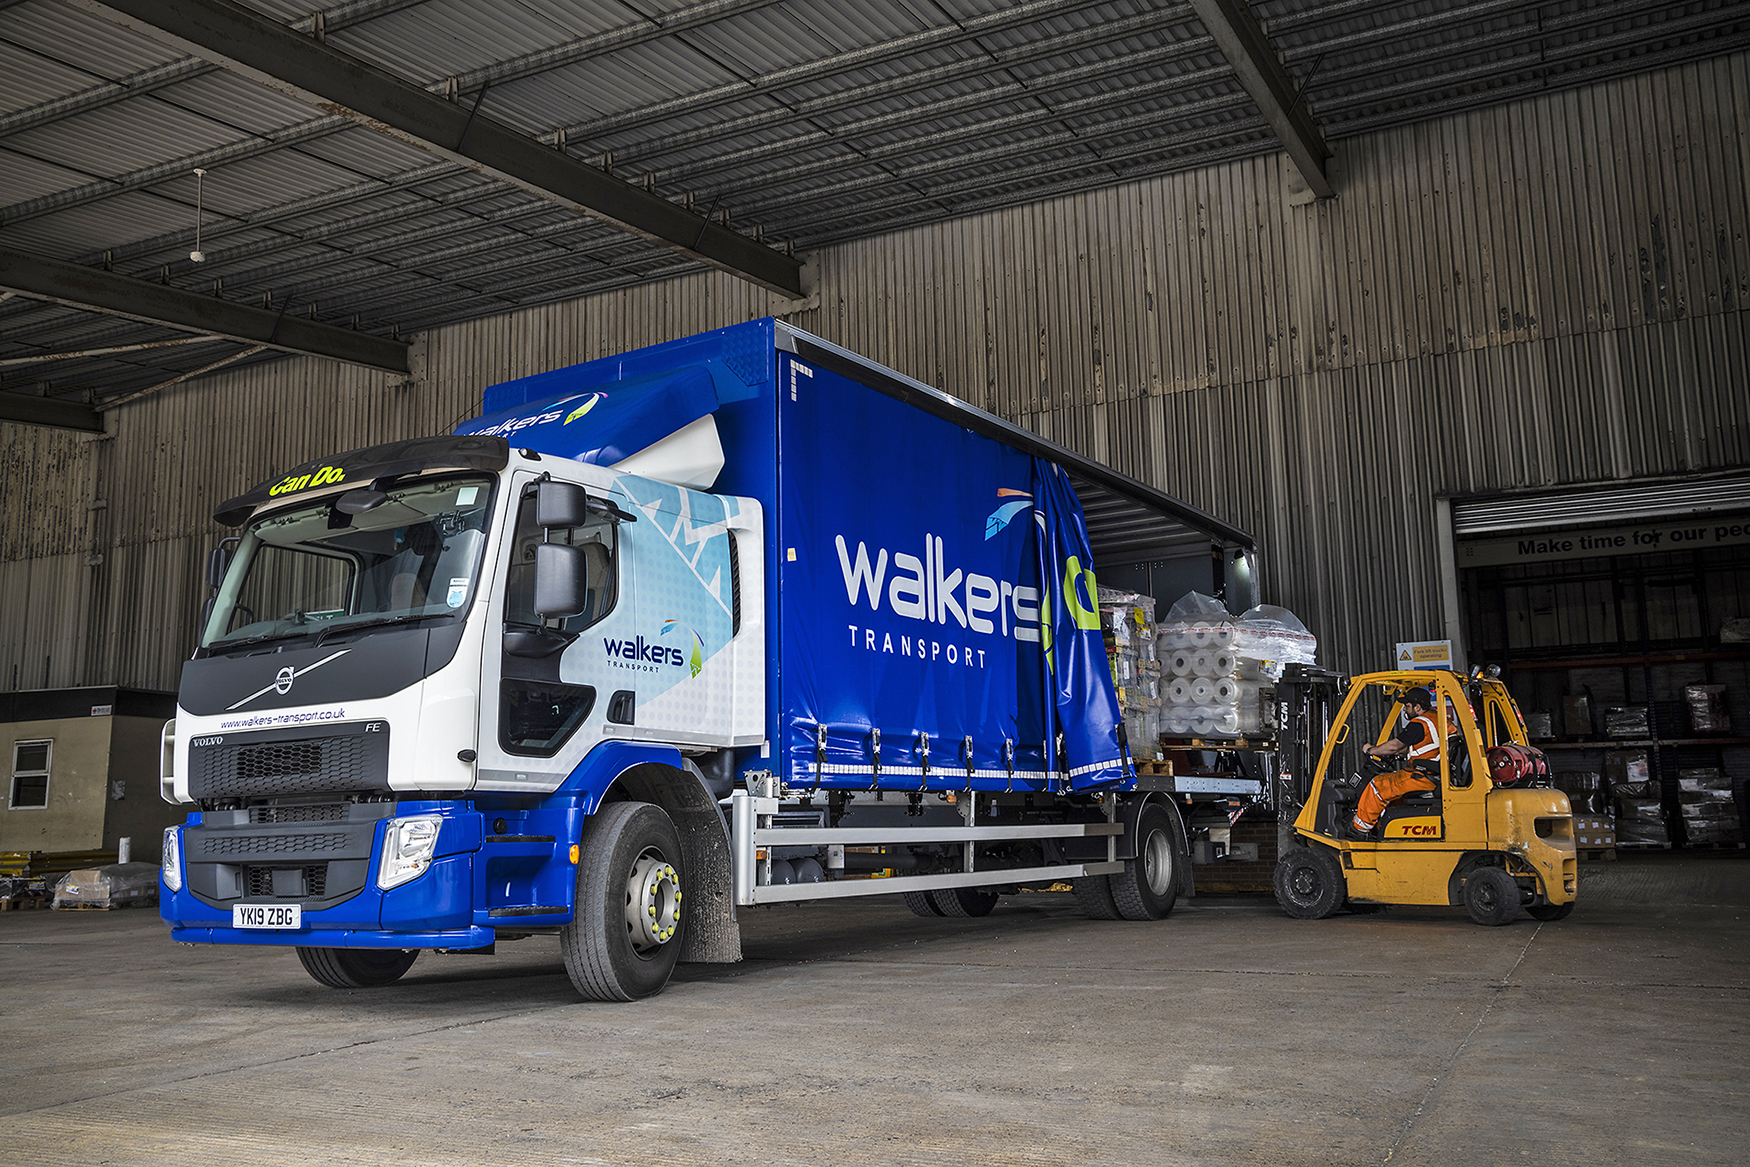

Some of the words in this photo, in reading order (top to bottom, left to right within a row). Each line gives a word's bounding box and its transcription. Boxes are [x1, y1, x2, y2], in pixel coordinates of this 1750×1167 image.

[269, 474, 312, 496] Can
[308, 466, 346, 488] Do.
[1517, 537, 1573, 555] Make
[1579, 534, 1626, 550] time
[1631, 530, 1663, 545] for
[1669, 527, 1707, 543] our
[835, 532, 1041, 643] walkers
[603, 635, 684, 667] walkers
[848, 624, 987, 669] TRANSPORT
[607, 660, 660, 673] TRANSPORT
[220, 707, 346, 729] www.walkers-transport.co.uk
[364, 722, 382, 733] FE
[1280, 701, 1289, 731] TCM
[193, 736, 224, 747] VOLVO
[1402, 825, 1437, 835] TCM
[240, 907, 265, 925] YK19
[267, 908, 293, 926] ZBG
